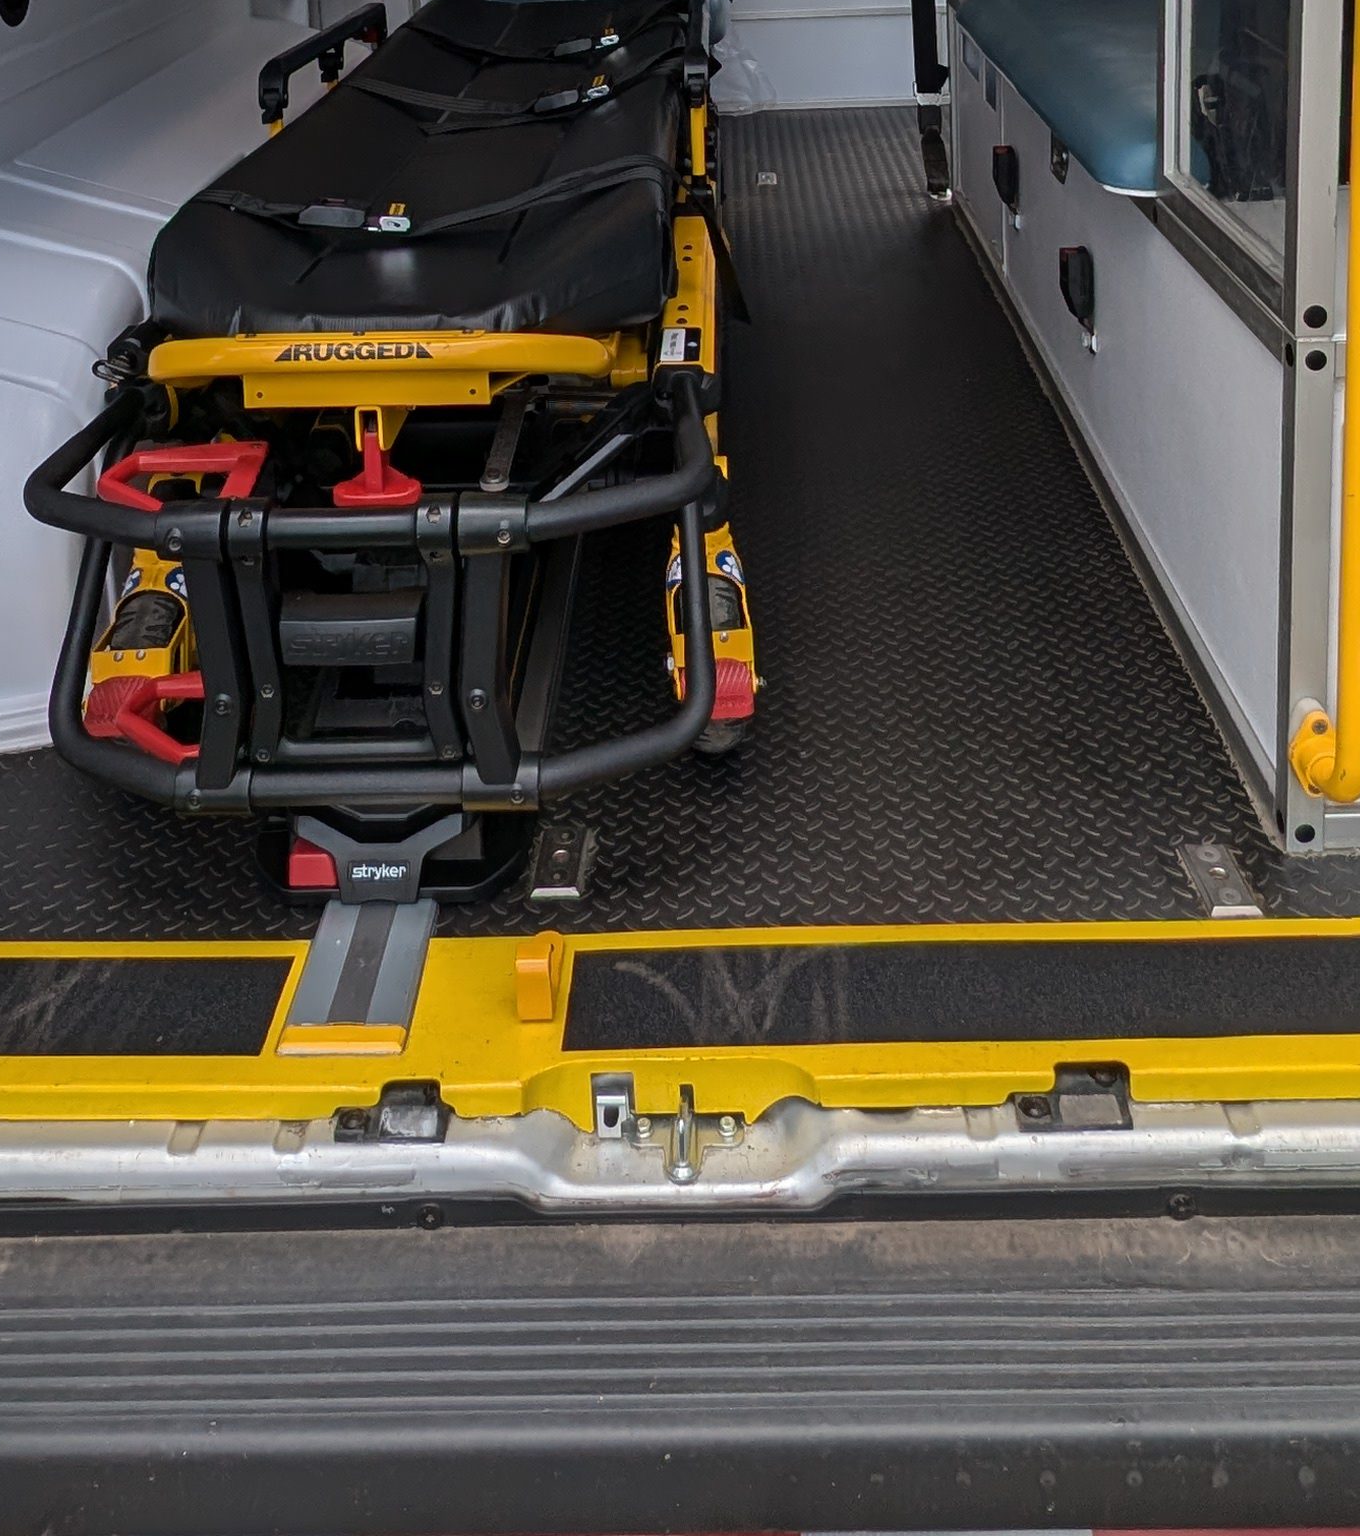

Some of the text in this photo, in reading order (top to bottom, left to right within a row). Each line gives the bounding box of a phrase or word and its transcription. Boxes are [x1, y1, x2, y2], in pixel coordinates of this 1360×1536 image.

[292, 341, 416, 362] RUGGED
[289, 626, 409, 661] stryker
[351, 863, 407, 880] stryker
